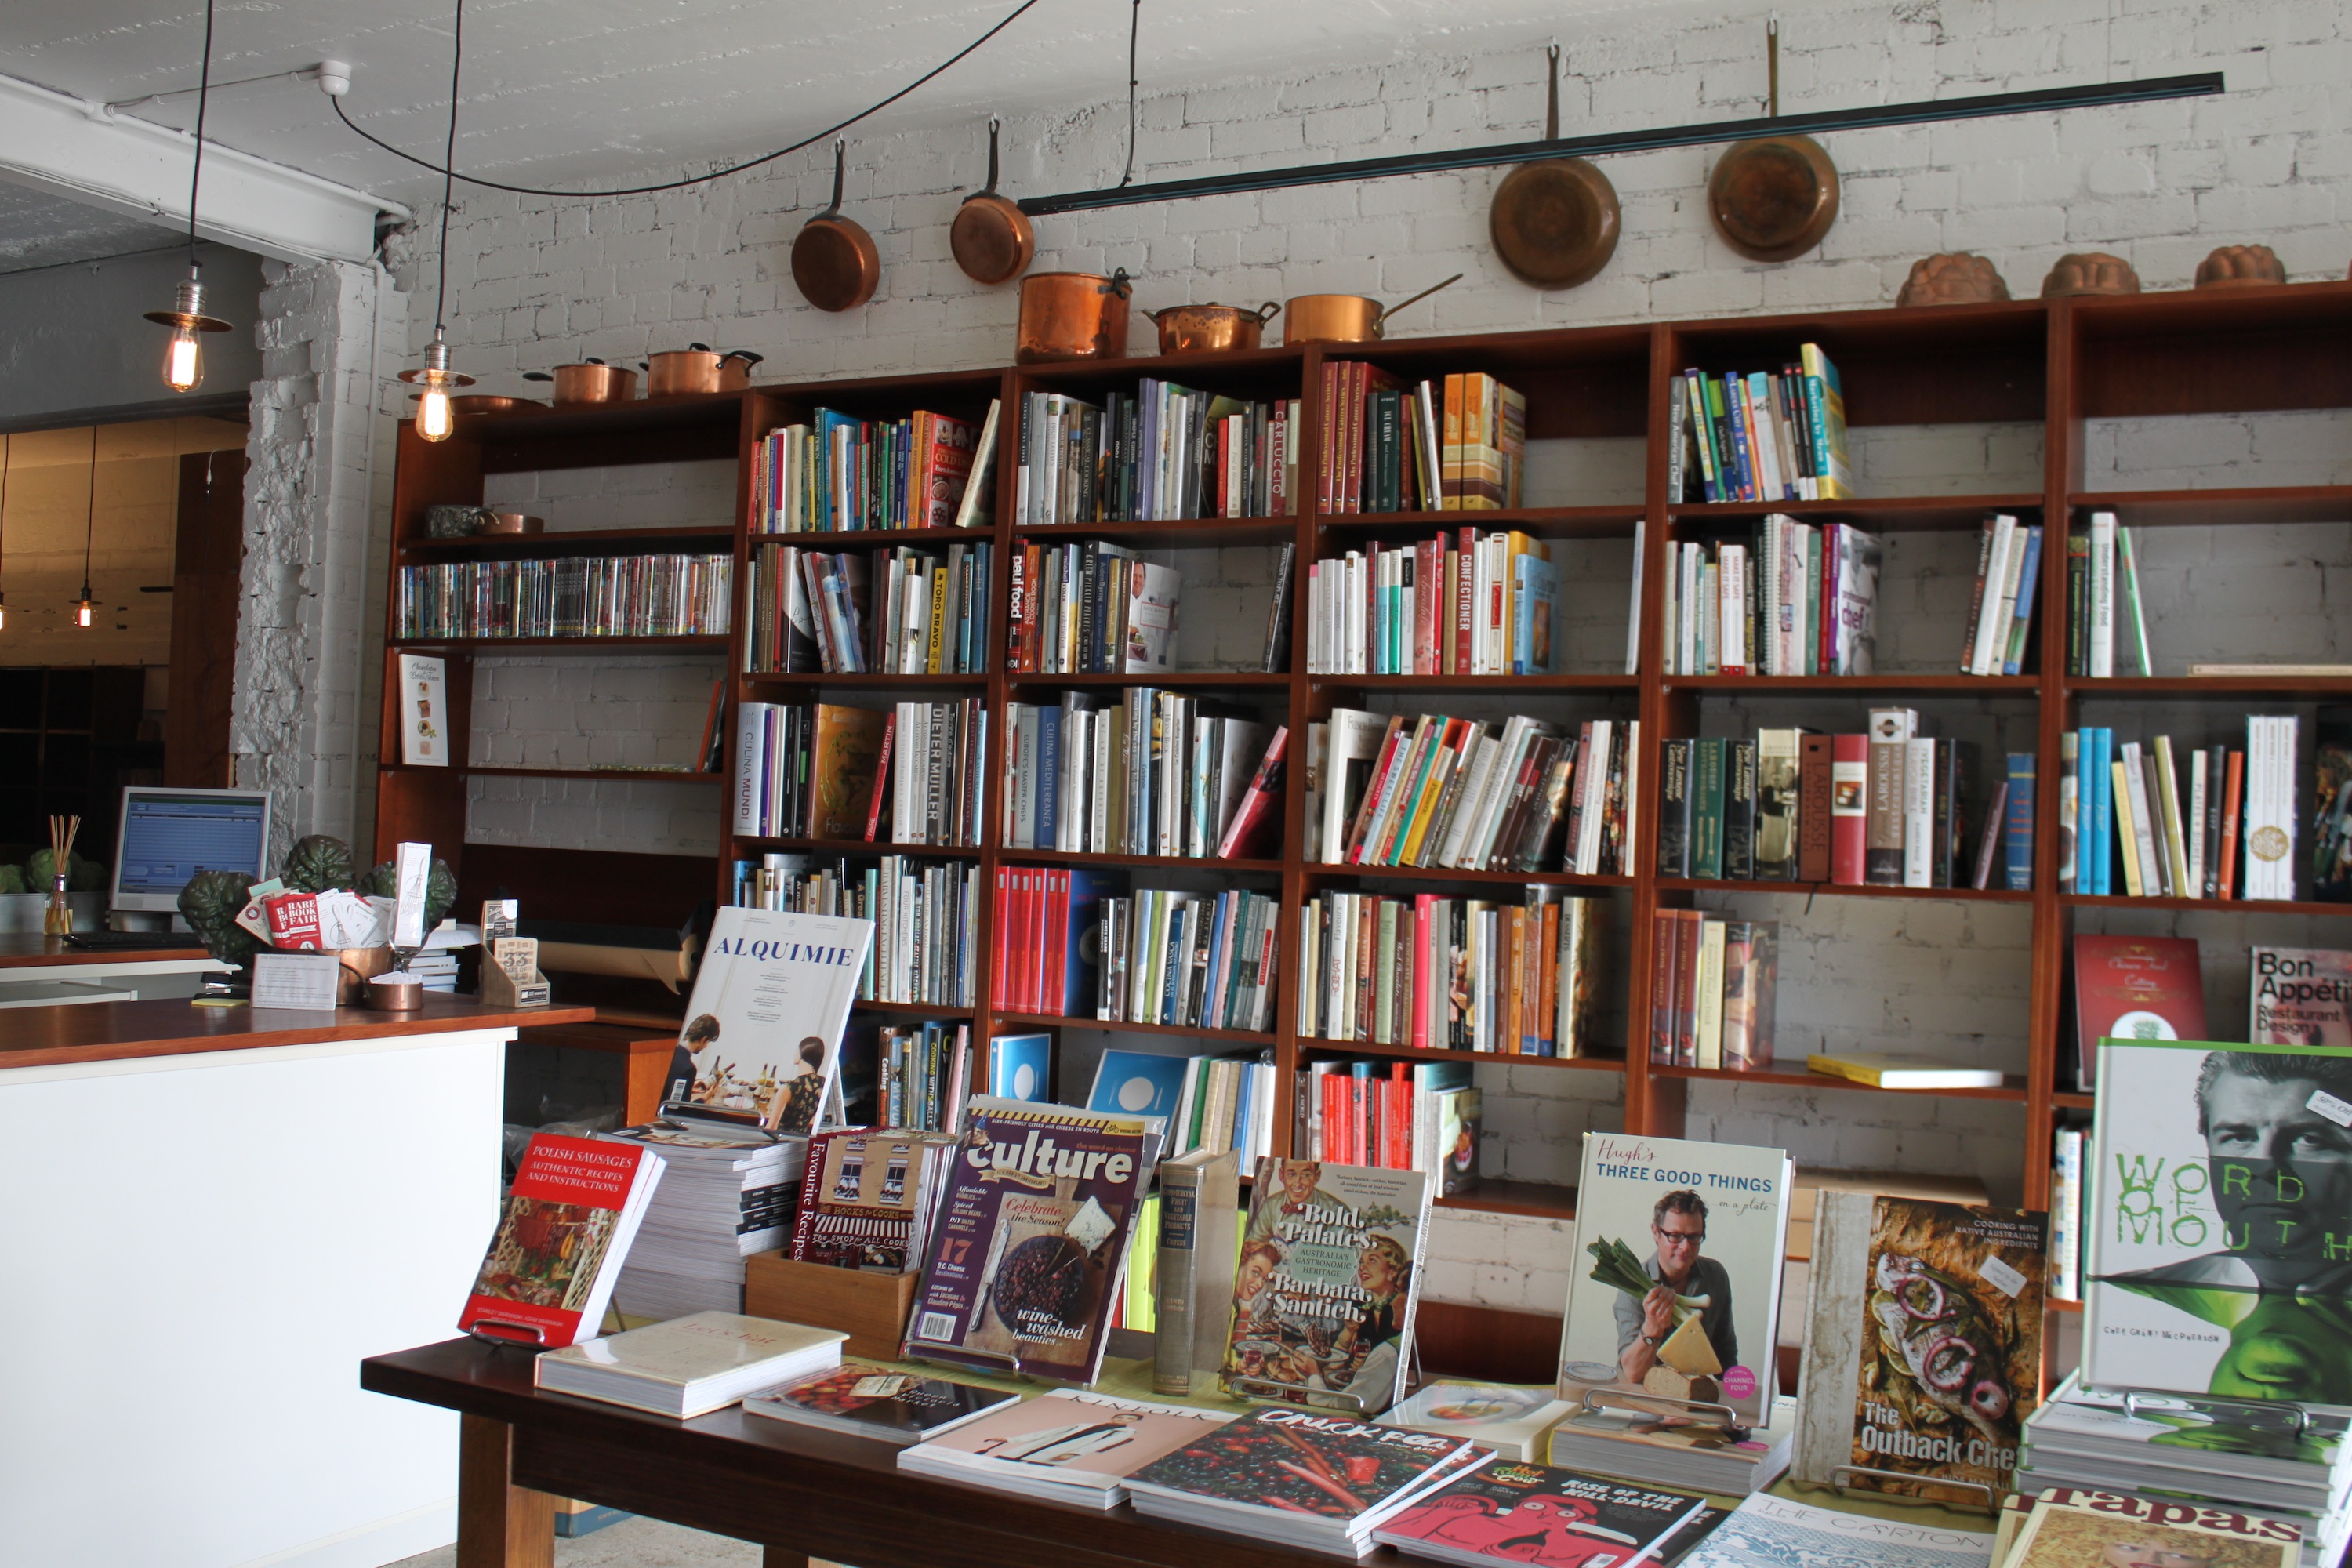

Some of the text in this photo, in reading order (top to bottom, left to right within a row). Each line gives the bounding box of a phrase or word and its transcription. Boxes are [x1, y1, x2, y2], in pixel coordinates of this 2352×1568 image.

[1809, 379, 1825, 462] Marketing by Menu
[1272, 411, 1284, 494] CARLUCCIO
[1670, 405, 1683, 486] New American Chef
[1011, 555, 1024, 618] paul food
[1084, 578, 1093, 603] PICKLED
[1459, 554, 1472, 630] CONFECTIONER
[2100, 543, 2110, 626] Understanding Food
[931, 613, 940, 648] BRAVO
[1083, 606, 1092, 632] PEACHES
[740, 732, 753, 821] CULINA MUNDI
[927, 708, 944, 820] DIETER MULLER
[1043, 722, 1055, 828] CULINA MEDITERRANEA
[1664, 744, 1677, 802] Gastronomique
[1675, 746, 1687, 800] New Larousse
[1733, 744, 1744, 803] Gastronomique
[1743, 746, 1755, 800] New Larousse
[1377, 746, 1406, 818] THE SWEET LIFE
[1878, 746, 1890, 811] LAROUSSE
[1811, 762, 1828, 852] LAROUSSE
[2192, 831, 2201, 866] DISHES
[288, 899, 316, 910] RARE
[289, 908, 317, 917] BOOK
[289, 914, 318, 925] FAIR
[1241, 902, 1256, 959] Gordon Ramsay
[503, 952, 528, 967] 33
[713, 936, 855, 967] ALQUIMIE
[1270, 941, 1279, 975] unplugged
[2257, 952, 2314, 978] Bon
[1163, 942, 1175, 997] COCINA VASCA
[2256, 976, 2352, 1004] Appéti
[2257, 1005, 2340, 1022] Restaurant
[2257, 1018, 2310, 1036] Design
[891, 1083, 902, 1127] MY VUE
[532, 1145, 633, 1169] POLISH SAUSAGES
[967, 1129, 1134, 1184] culture
[1598, 1138, 1658, 1165] Hugh's
[525, 1171, 620, 1193] AND INSTRUCTIONS
[529, 1161, 624, 1182] AUTHENTIC RECIPES
[1596, 1163, 1773, 1192] THREE GOOD THINGS
[2116, 1152, 2304, 1203] WORD
[792, 1142, 826, 1261] Favourite Recipes
[956, 1185, 988, 1196] Affordable
[1163, 1188, 1196, 1199] COMMERCIAL
[1171, 1197, 1187, 1207] FRUIT
[953, 1200, 973, 1210] Spiced
[1006, 1198, 1062, 1218] Celebrate
[1163, 1212, 1192, 1222] VEGETABLE
[1298, 1203, 1365, 1229] Bold
[1163, 1221, 1192, 1231] PRODUCTS
[1279, 1222, 1377, 1250] Palates
[1955, 1225, 2038, 1241] NATIVE AUSTRALIAN
[1974, 1220, 2039, 1232] COOKING WITH
[2118, 1205, 2352, 1261] MOUTH
[831, 1234, 855, 1243] SHOP
[863, 1236, 880, 1244] ALL
[883, 1238, 909, 1247] COOKS
[938, 1237, 973, 1265] 17
[1299, 1247, 1350, 1261] AUSTRALIA'S
[1983, 1236, 2038, 1250] INGREDIENTS
[1294, 1257, 1352, 1271] GASTRONOMIC
[1302, 1266, 1341, 1279] HERITAGE
[1267, 1272, 1373, 1303] Barbara
[477, 1307, 498, 1316] STANLEY
[1015, 1308, 1058, 1325] wine-
[1266, 1292, 1367, 1323] Santich
[1012, 1330, 1057, 1346] beauties
[1026, 1323, 1087, 1341] washed
[909, 1388, 946, 1399] Queen
[1724, 1376, 1755, 1385] CHANNEL
[890, 1396, 935, 1409] Market
[902, 1392, 960, 1407] Victoria
[1069, 1394, 1216, 1421] KINFOLK
[1864, 1400, 1900, 1426] The
[1860, 1425, 2022, 1471] Outback Che
[1561, 1479, 1685, 1506] RISE OF THE
[1562, 1487, 1675, 1512] KILL-DEVIL
[1762, 1497, 1984, 1548] THE CARTON
[2038, 1487, 2303, 1543] Tapas
